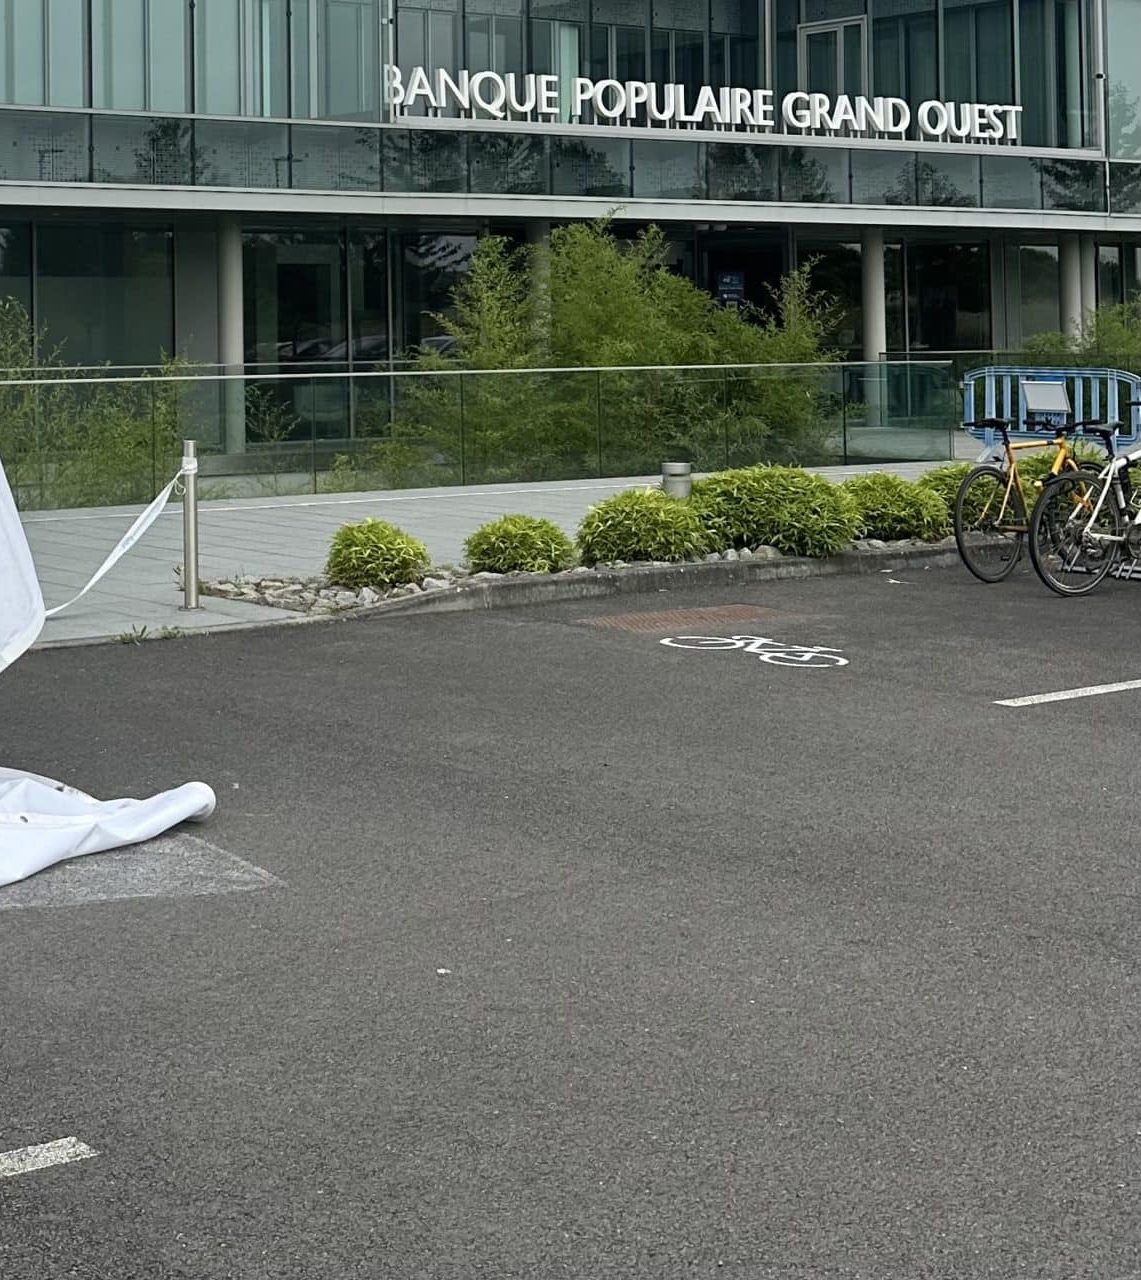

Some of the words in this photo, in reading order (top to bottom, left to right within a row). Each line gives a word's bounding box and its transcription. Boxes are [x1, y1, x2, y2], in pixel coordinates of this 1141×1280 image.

[384, 64, 560, 117] BANQUE
[572, 76, 774, 126] POPULAIRE
[782, 91, 911, 133] GRAND
[918, 99, 1023, 140] OUEST
